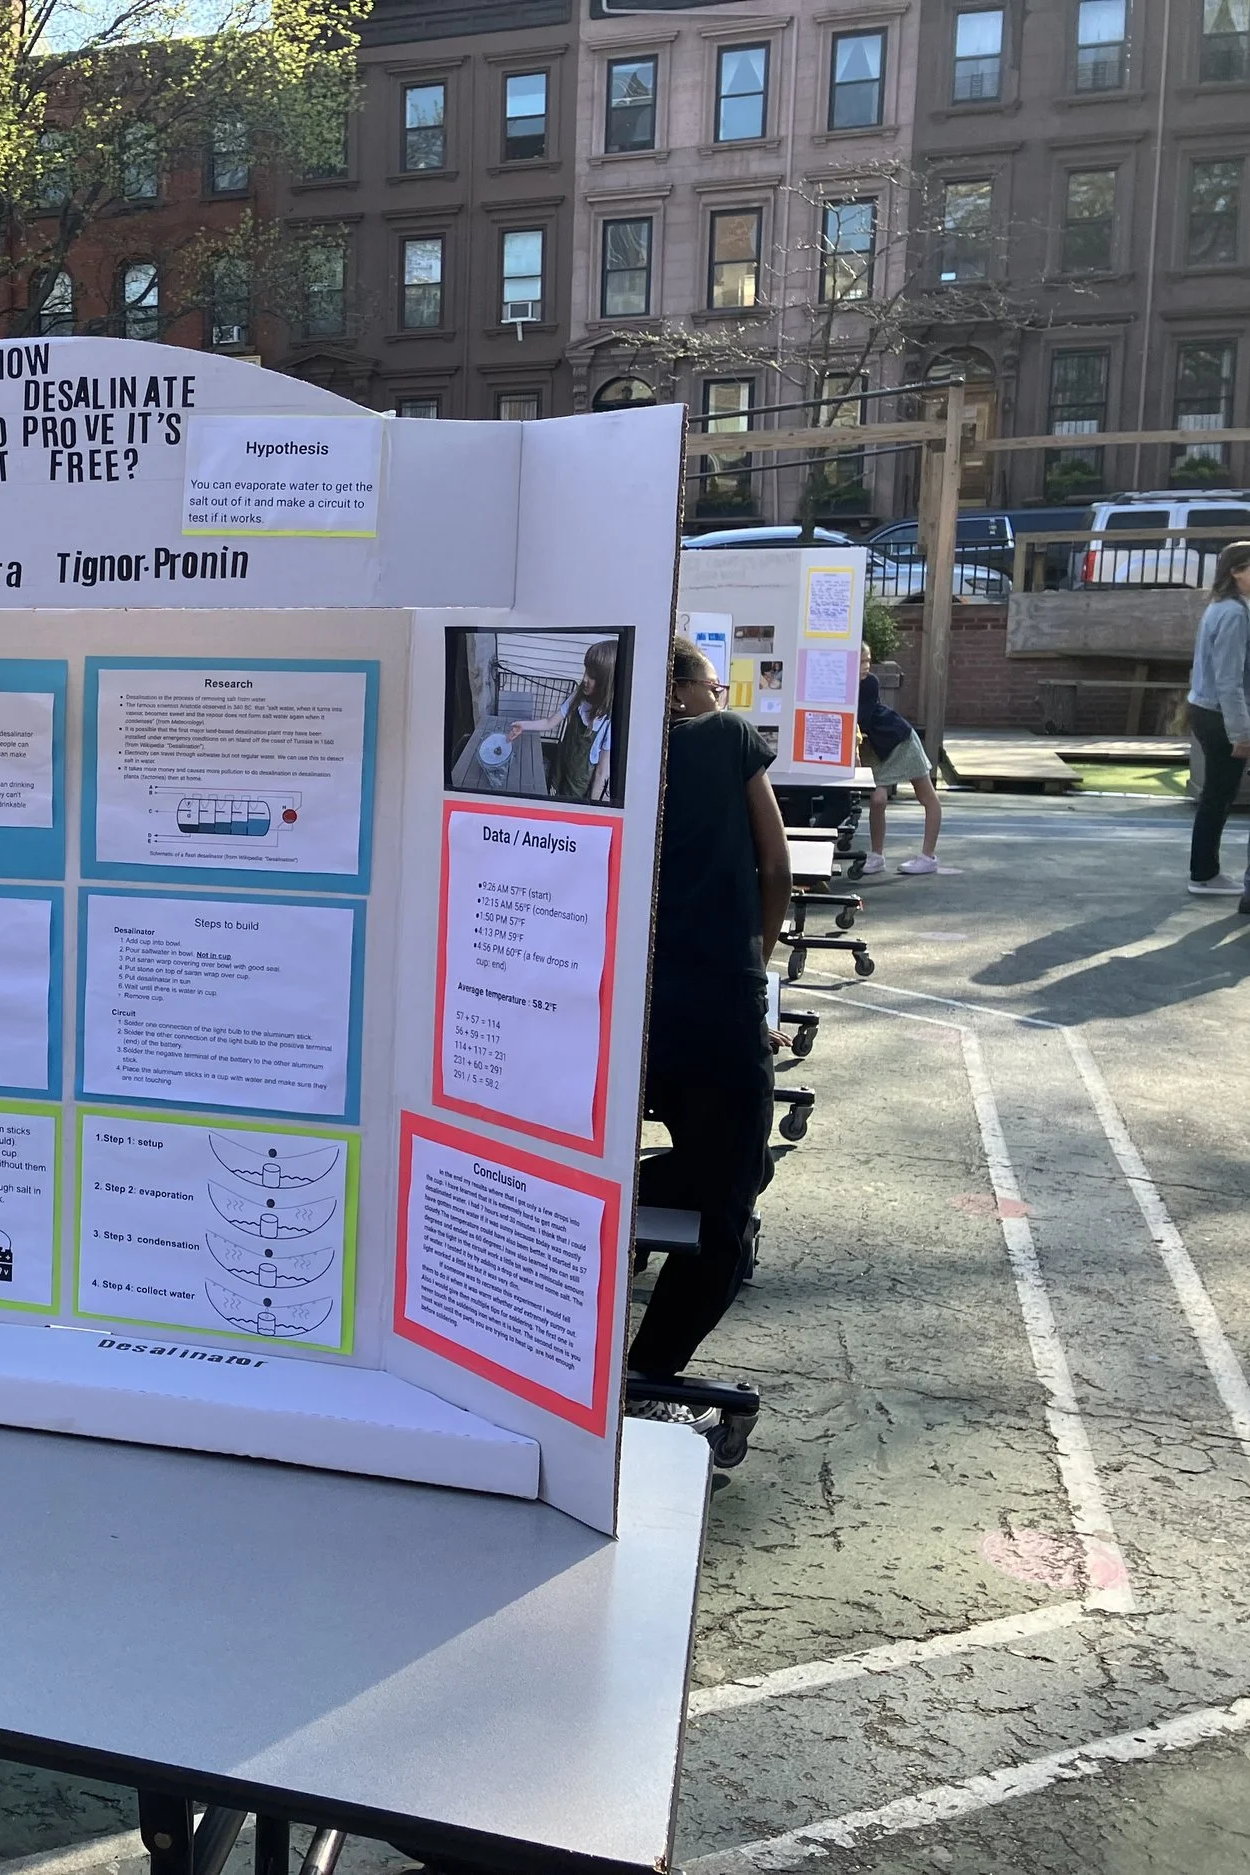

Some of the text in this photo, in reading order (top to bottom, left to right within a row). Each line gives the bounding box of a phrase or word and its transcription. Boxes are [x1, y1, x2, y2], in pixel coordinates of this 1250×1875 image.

[21, 373, 195, 414] DESALINATE
[23, 413, 114, 449] PROVE
[128, 412, 181, 445] IT'S
[247, 441, 328, 457] Hypothesis
[47, 447, 138, 483] FREE?
[191, 480, 373, 494] You can evaporate water to get the
[190, 496, 365, 509] salt out of it and make a circuit to
[188, 513, 262, 524] test if it works.
[205, 679, 252, 688] Research
[483, 826, 577, 854] Data / Analysis
[114, 926, 155, 936] Desalinator
[194, 918, 259, 931] Steps to build
[111, 1009, 136, 1017] Circuit
[6, 1126, 31, 1136] sticks
[96, 1133, 164, 1150] 1.Step 1: setup
[473, 1163, 527, 1192] Conclusion
[16, 1185, 31, 1194] salt
[94, 1182, 194, 1201] 2. Step 2: evaporation
[93, 1229, 101, 1238] 3.
[103, 1230, 125, 1243] Step
[137, 1237, 200, 1251] condensation
[92, 1279, 195, 1300] 4. Step 4: collect water
[98, 1338, 268, 1369] Desalinator
